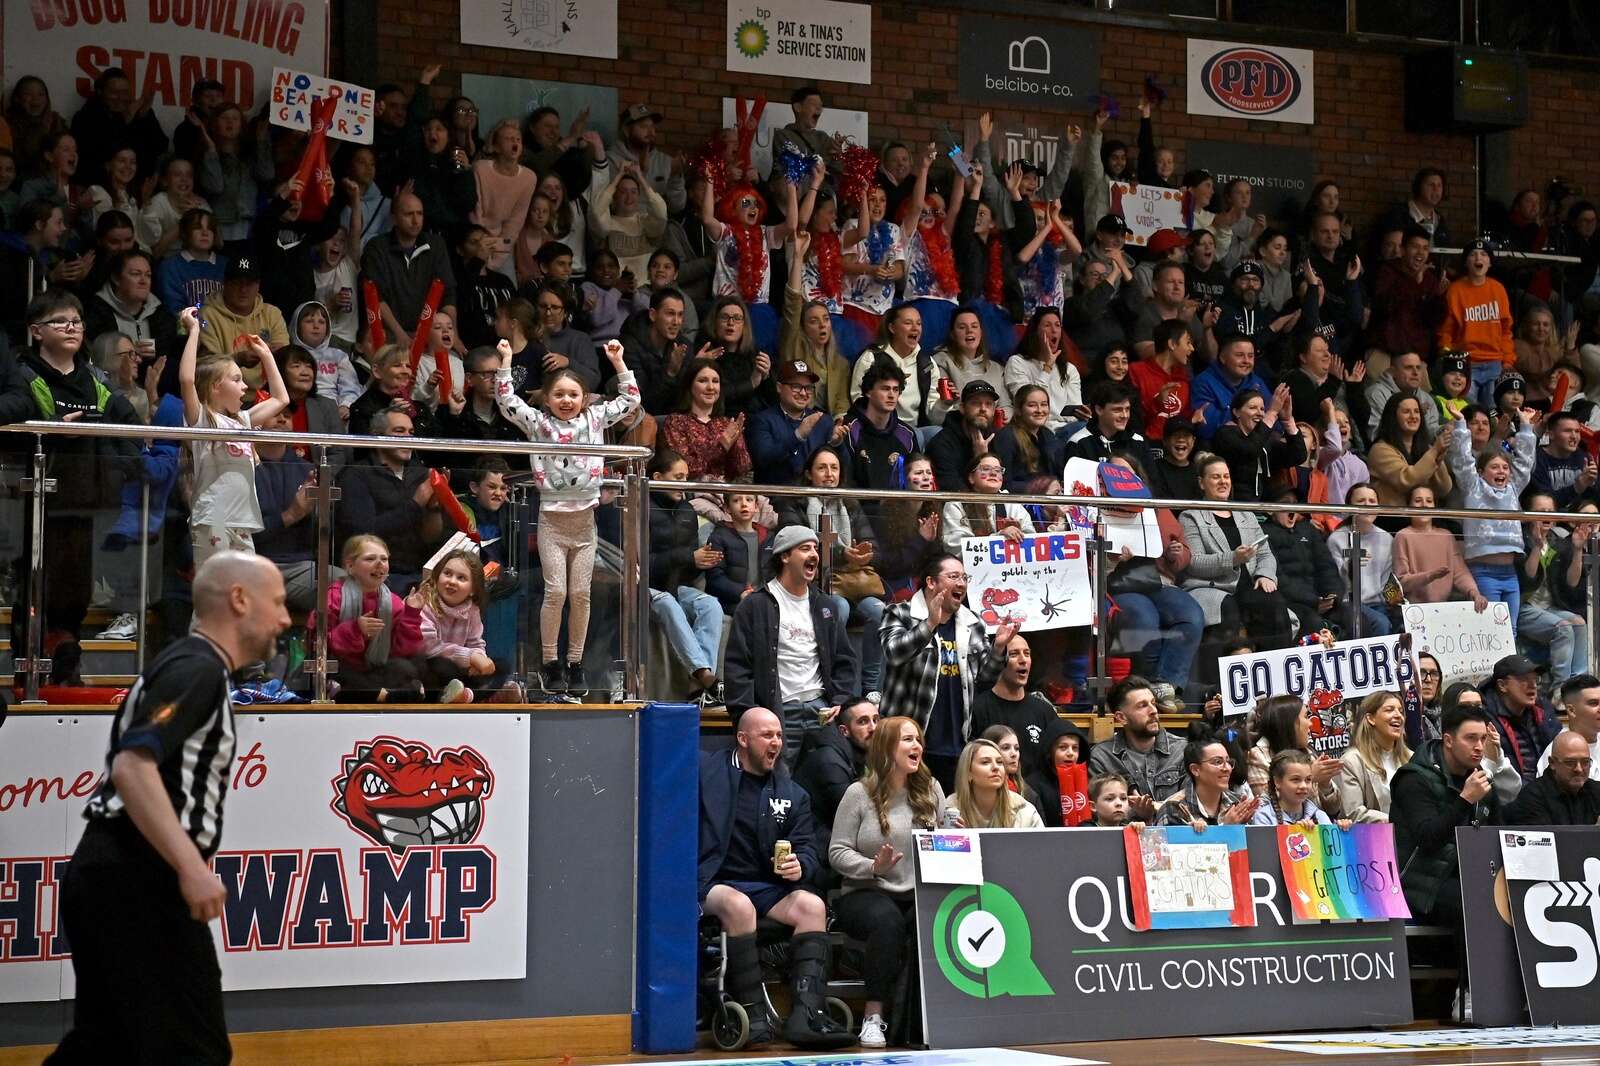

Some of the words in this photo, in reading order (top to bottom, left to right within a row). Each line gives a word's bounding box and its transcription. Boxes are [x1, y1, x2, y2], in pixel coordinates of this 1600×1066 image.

[756, 7, 771, 20] bp
[777, 21, 796, 37] PAT
[799, 24, 807, 38] &
[810, 24, 843, 41] TINA'S
[777, 40, 821, 58] SERVICE
[825, 44, 866, 62] STATION
[76, 45, 255, 112] STAND
[985, 74, 1039, 94] belcibo
[1052, 84, 1073, 97] co.
[1219, 59, 1288, 98] PFD
[1266, 177, 1305, 191] STUDIO
[1464, 301, 1501, 322] JORDAN
[965, 540, 989, 553] Lets
[989, 533, 1081, 565] GATORS
[972, 554, 984, 567] go
[1434, 634, 1455, 655] GO
[1459, 632, 1503, 654] GATORS
[1225, 656, 1273, 708] GO
[1282, 640, 1415, 699] GATORS
[232, 742, 268, 791] to
[1322, 827, 1342, 857] GO
[208, 845, 498, 953] WAMP
[1074, 962, 1153, 994] CIVIL
[1160, 951, 1396, 990] CONSTRUCTION
